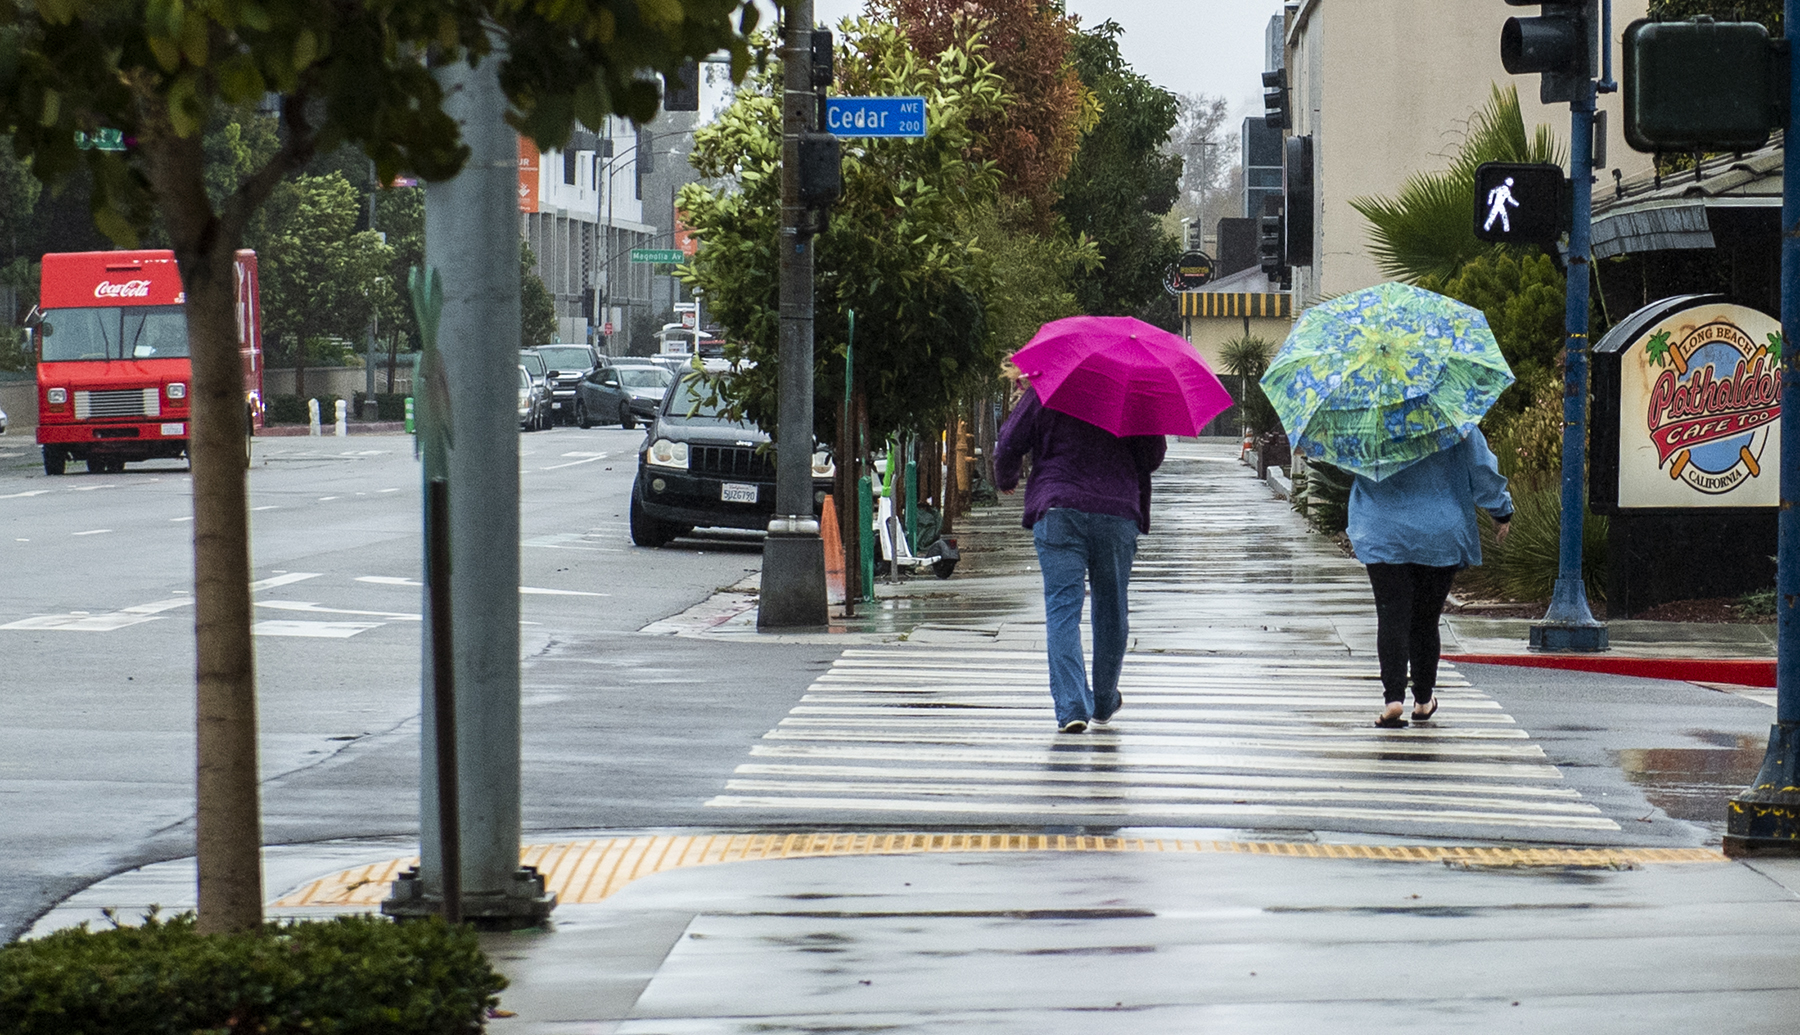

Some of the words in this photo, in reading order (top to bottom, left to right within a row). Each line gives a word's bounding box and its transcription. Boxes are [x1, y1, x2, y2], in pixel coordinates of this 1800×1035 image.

[828, 106, 888, 128] Cedar
[900, 103, 918, 113] AVE
[899, 121, 920, 131] 200
[633, 252, 668, 261] Magnolia
[94, 280, 151, 298] Coca-Cola
[1682, 328, 1713, 355] LONG
[1716, 327, 1753, 356] BEACH
[1666, 418, 1732, 444] CAFE
[1688, 468, 1742, 489] CALIFORNIA
